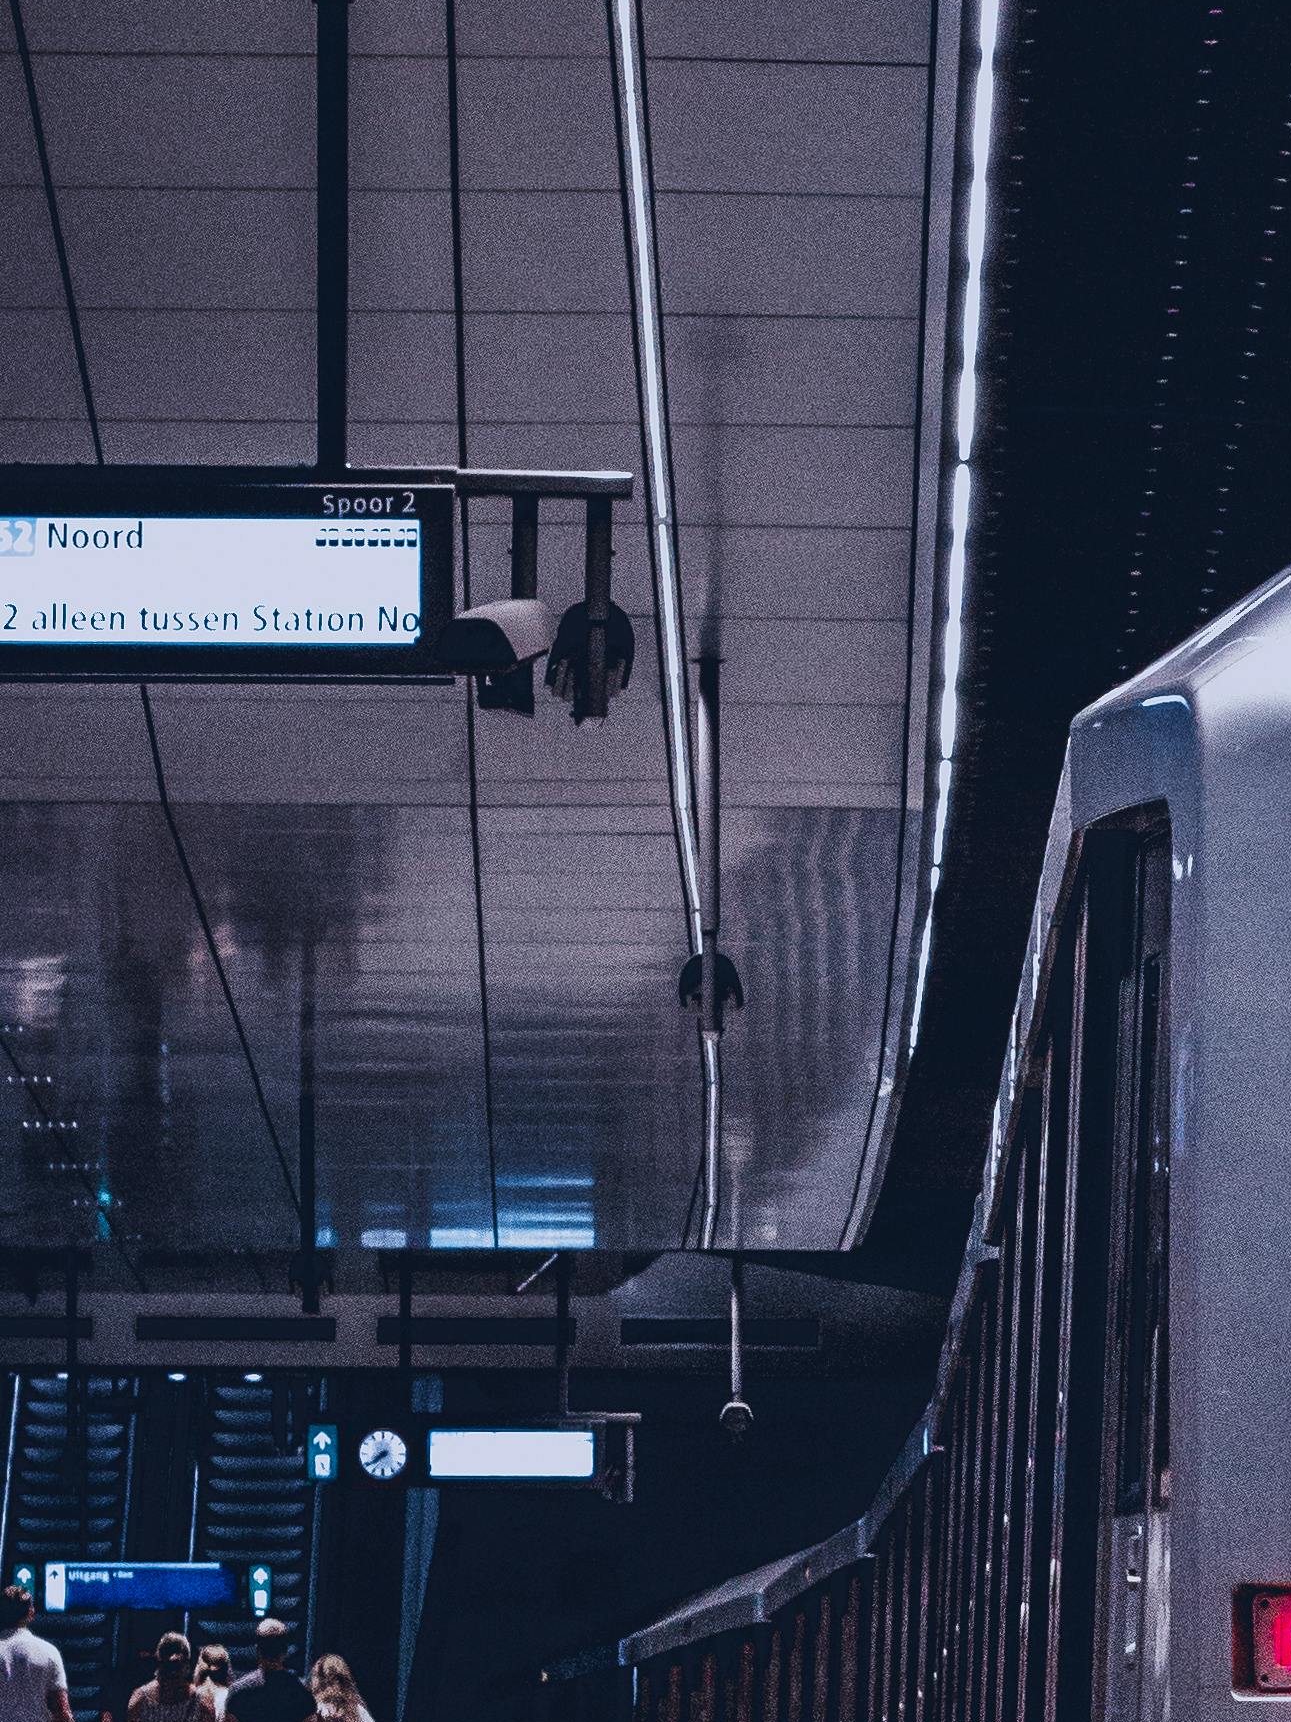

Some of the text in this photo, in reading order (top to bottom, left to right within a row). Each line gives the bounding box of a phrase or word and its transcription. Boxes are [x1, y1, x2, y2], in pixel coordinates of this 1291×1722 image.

[322, 491, 417, 518] Spoor 2
[48, 520, 144, 550] Noord
[32, 602, 126, 632] alleen
[139, 607, 239, 632] tussen
[252, 604, 365, 632] Station
